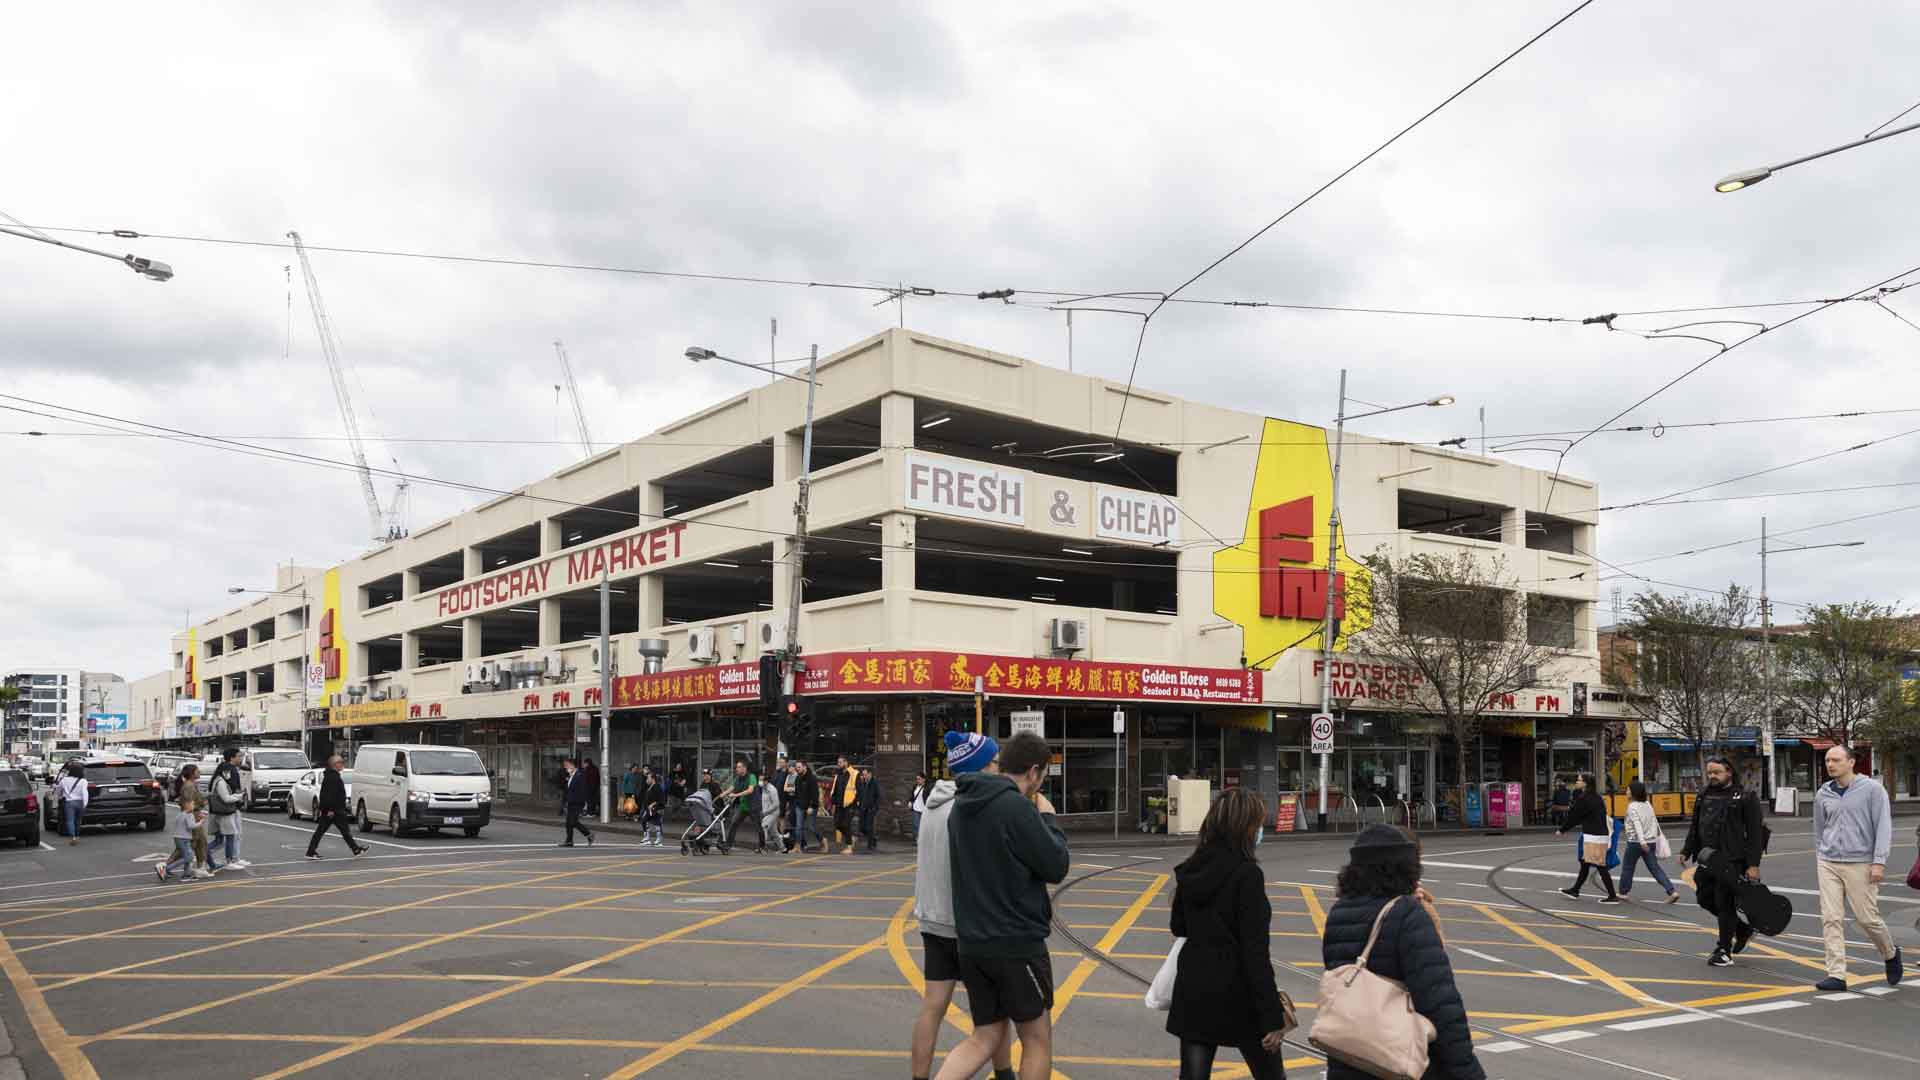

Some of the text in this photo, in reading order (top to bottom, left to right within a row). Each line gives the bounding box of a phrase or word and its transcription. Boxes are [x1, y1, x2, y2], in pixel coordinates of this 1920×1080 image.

[910, 463, 1176, 538] FRESH & CHEAP
[438, 522, 688, 617] FOOTSCRAY MARKET
[719, 665, 760, 684] Golden Hor
[839, 657, 931, 684] 金馬酒家
[1142, 668, 1209, 686] Golden Horse
[1313, 660, 1437, 684] FOOTSCRA
[553, 690, 570, 708] FM
[1142, 686, 1171, 696] Seafood
[1202, 689, 1241, 699] Restaurant
[1332, 680, 1418, 701] MARKET
[524, 694, 540, 710] FM
[1488, 693, 1516, 710] FM
[1535, 695, 1560, 712] FM
[1315, 723, 1330, 734] 40
[1312, 743, 1334, 751] AREA
